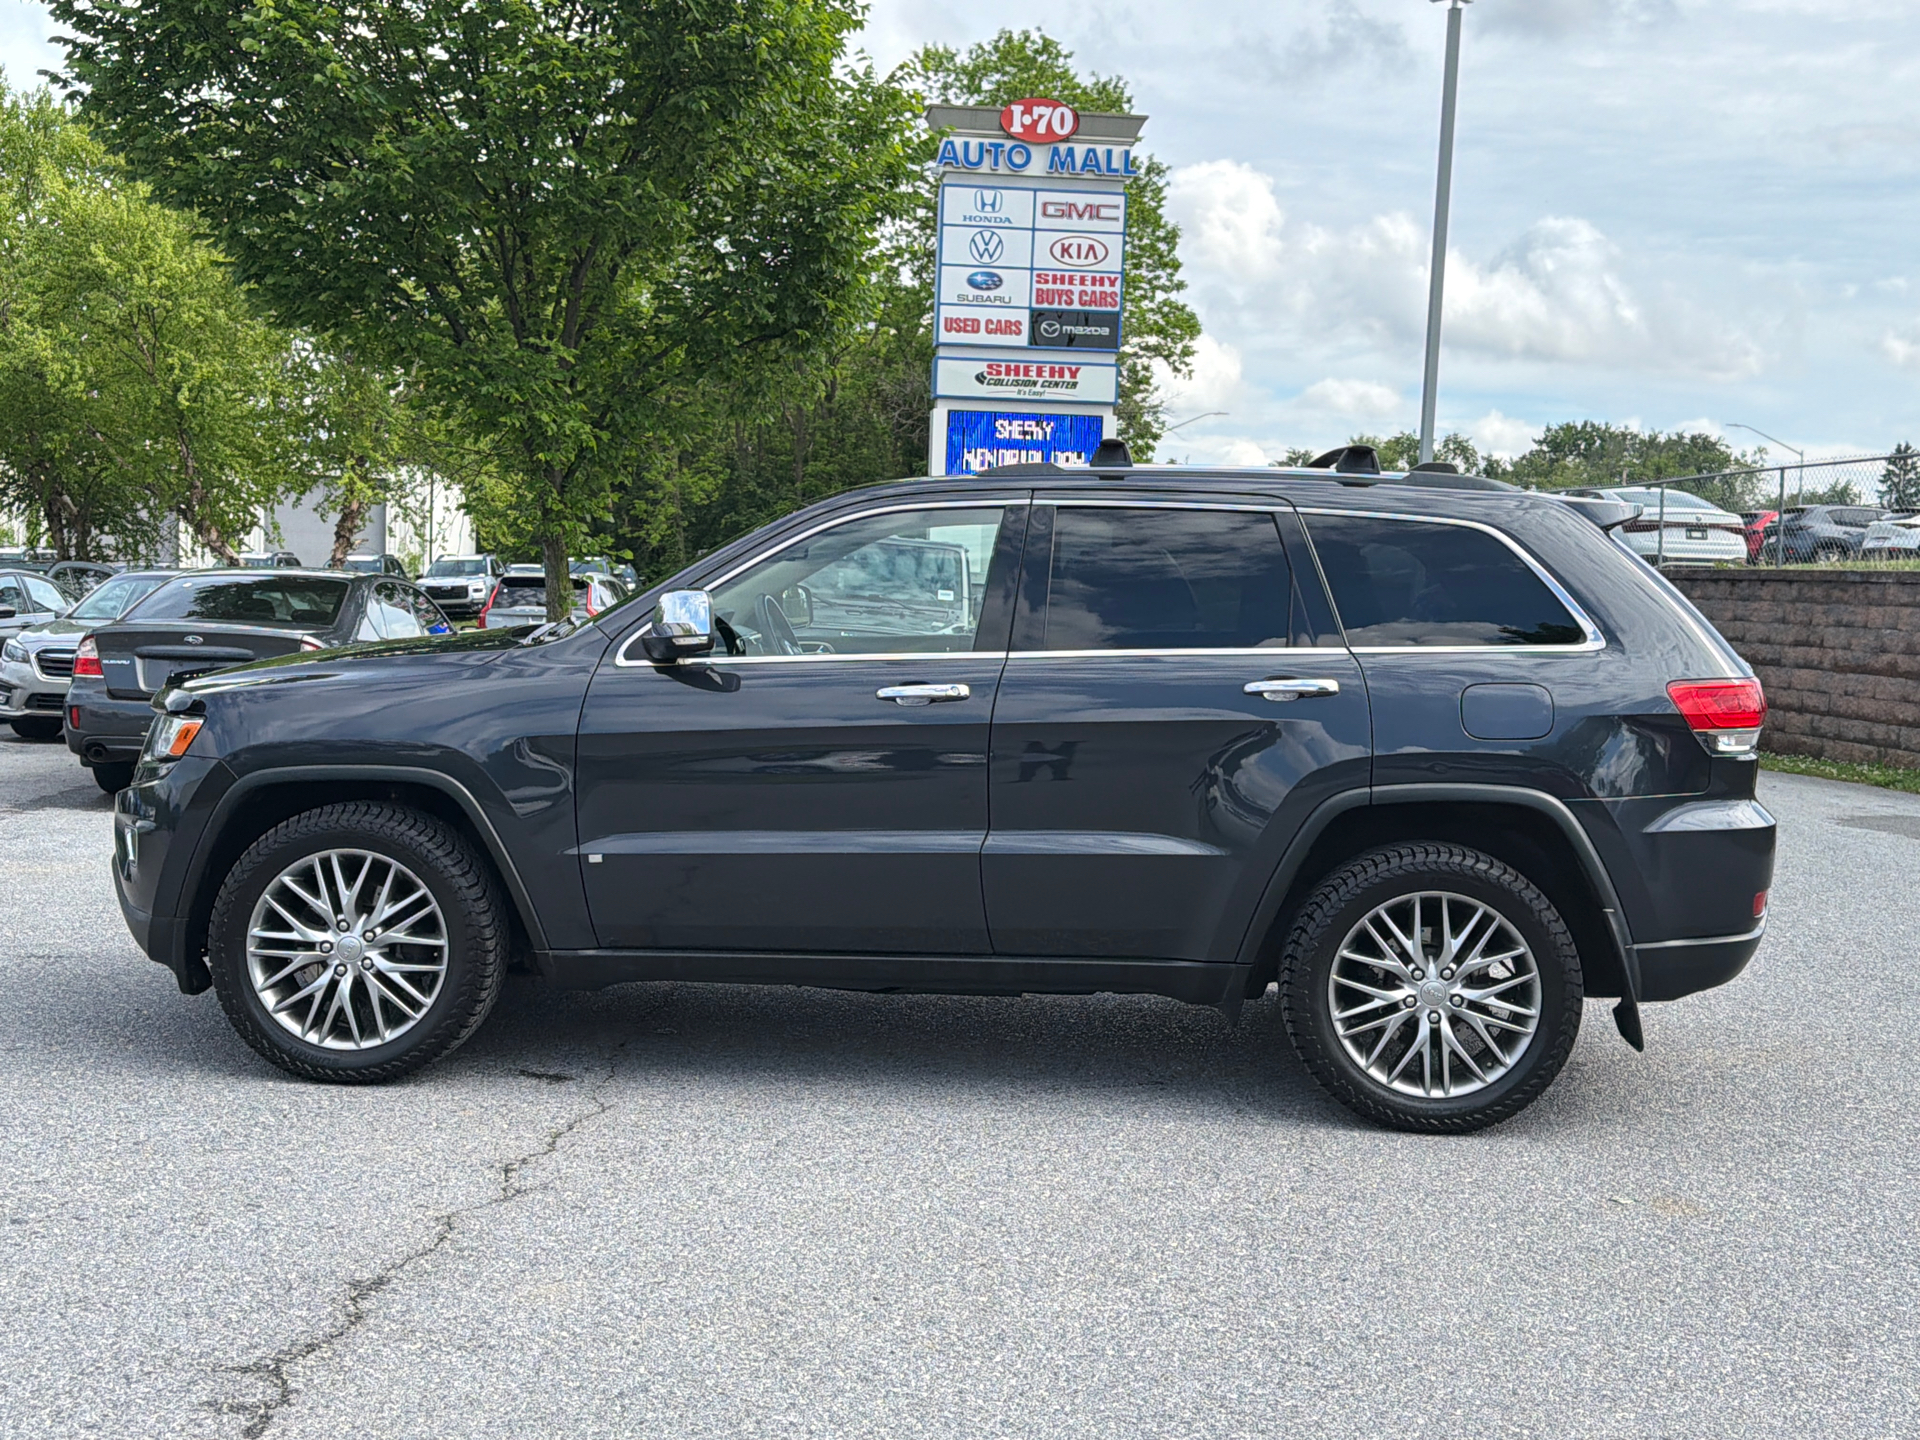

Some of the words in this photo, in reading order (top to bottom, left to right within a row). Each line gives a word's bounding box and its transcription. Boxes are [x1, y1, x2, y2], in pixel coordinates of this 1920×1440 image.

[937, 140, 1032, 171] AUTO
[1047, 146, 1138, 176] MALL
[962, 214, 1013, 224] HONDA
[1041, 201, 1120, 221] GMC
[1060, 242, 1099, 260] KIA
[1035, 273, 1119, 287] SHEEHY
[957, 294, 1012, 304] SUBARU
[1035, 288, 1074, 306] BUYS
[1078, 290, 1119, 308] CARS
[944, 317, 980, 334] USED
[985, 319, 1023, 336] CARS
[986, 363, 1082, 379] SHEEHY
[986, 378, 1037, 388] COLLISION
[1040, 380, 1079, 389] CENTER
